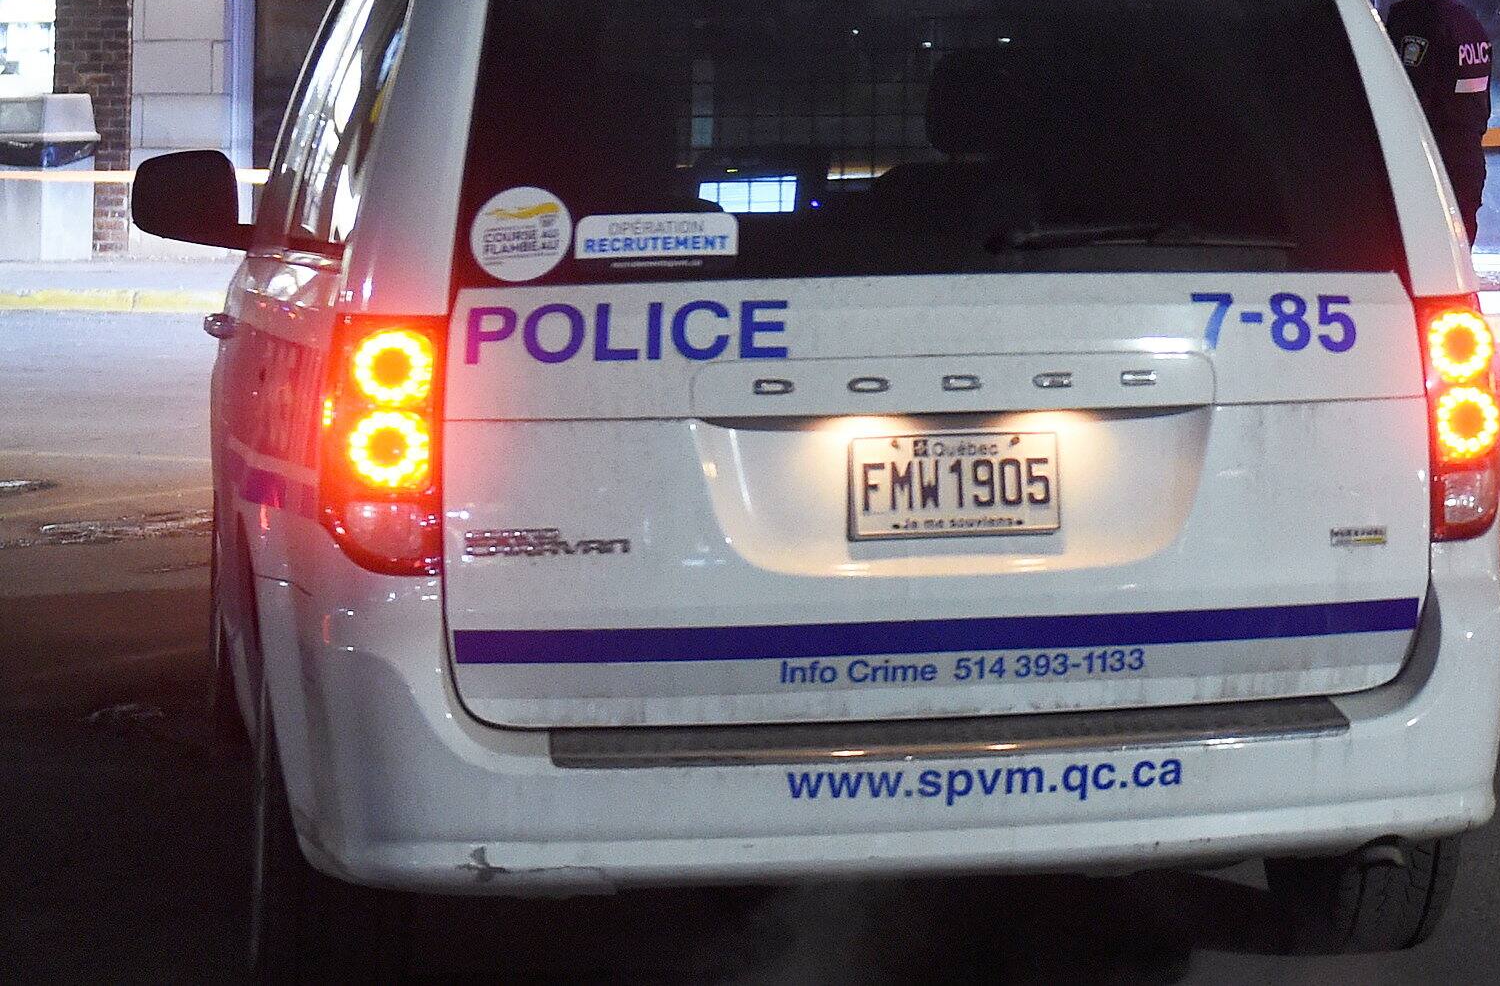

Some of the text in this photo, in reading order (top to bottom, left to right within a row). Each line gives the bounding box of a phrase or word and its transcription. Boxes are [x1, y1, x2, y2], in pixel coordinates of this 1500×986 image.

[583, 234, 730, 253] RECRUTEMENT
[463, 299, 789, 365] POLICE
[1190, 292, 1357, 353] 7-85
[753, 370, 1158, 395] DODGE
[779, 649, 1145, 685] Info Crime 514 393-1133
[786, 756, 1184, 807] www.spvm.qc.ca
